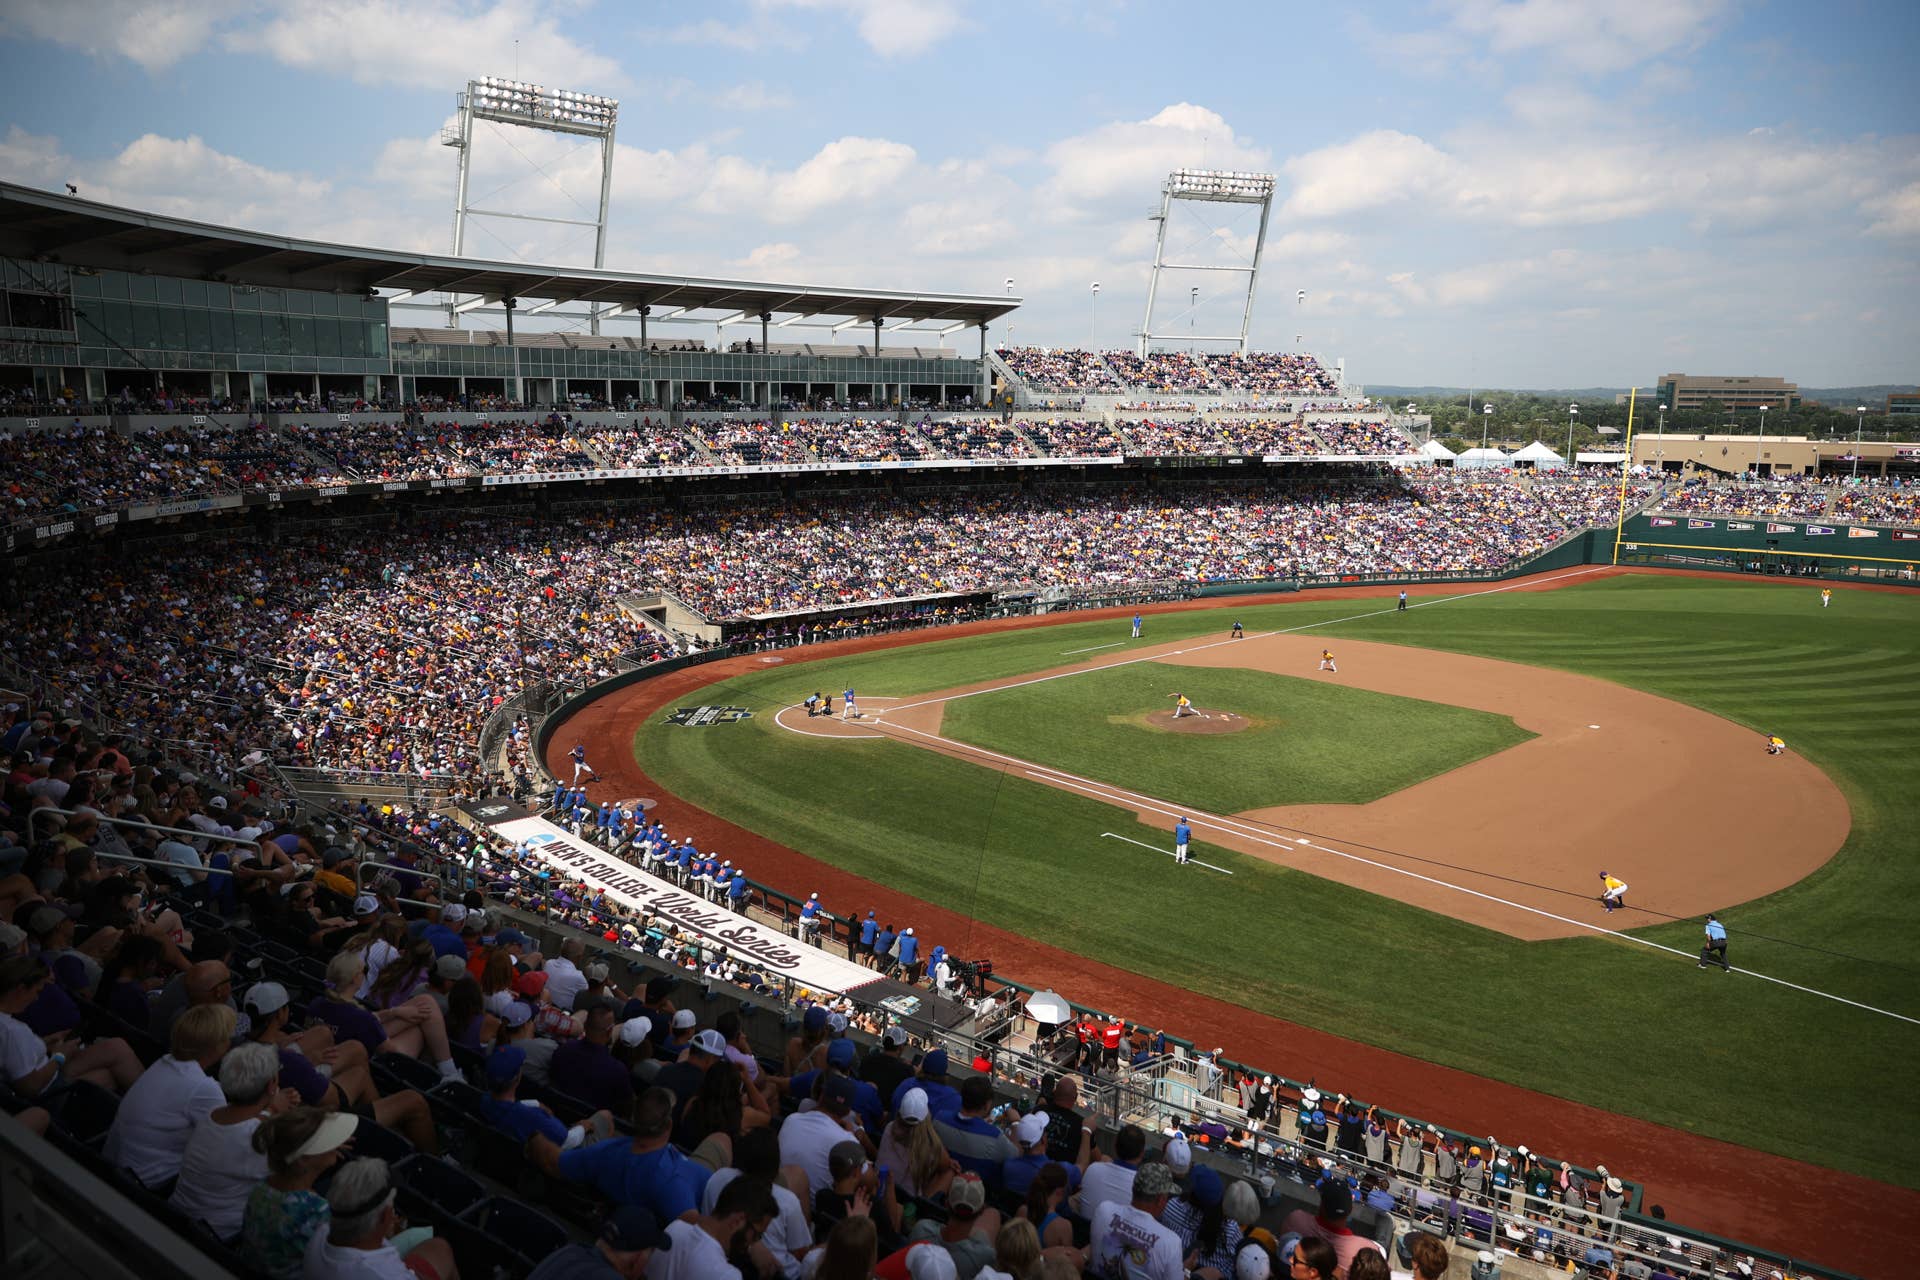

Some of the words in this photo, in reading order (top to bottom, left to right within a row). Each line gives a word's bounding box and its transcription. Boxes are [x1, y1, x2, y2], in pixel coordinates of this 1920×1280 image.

[383, 482, 409, 491] VIRGINIA
[430, 480, 446, 488] WAKE
[447, 478, 466, 487] FOREST
[318, 486, 348, 497] TENNESSEE
[269, 493, 281, 502] TCU
[95, 512, 118, 526] STANFORD
[36, 526, 50, 539] ORAL
[50, 521, 74, 536] ROBERTS
[540, 840, 596, 867] MEN'S
[581, 863, 658, 899] COLLEGE
[648, 892, 734, 929] World
[718, 926, 801, 964] Series
